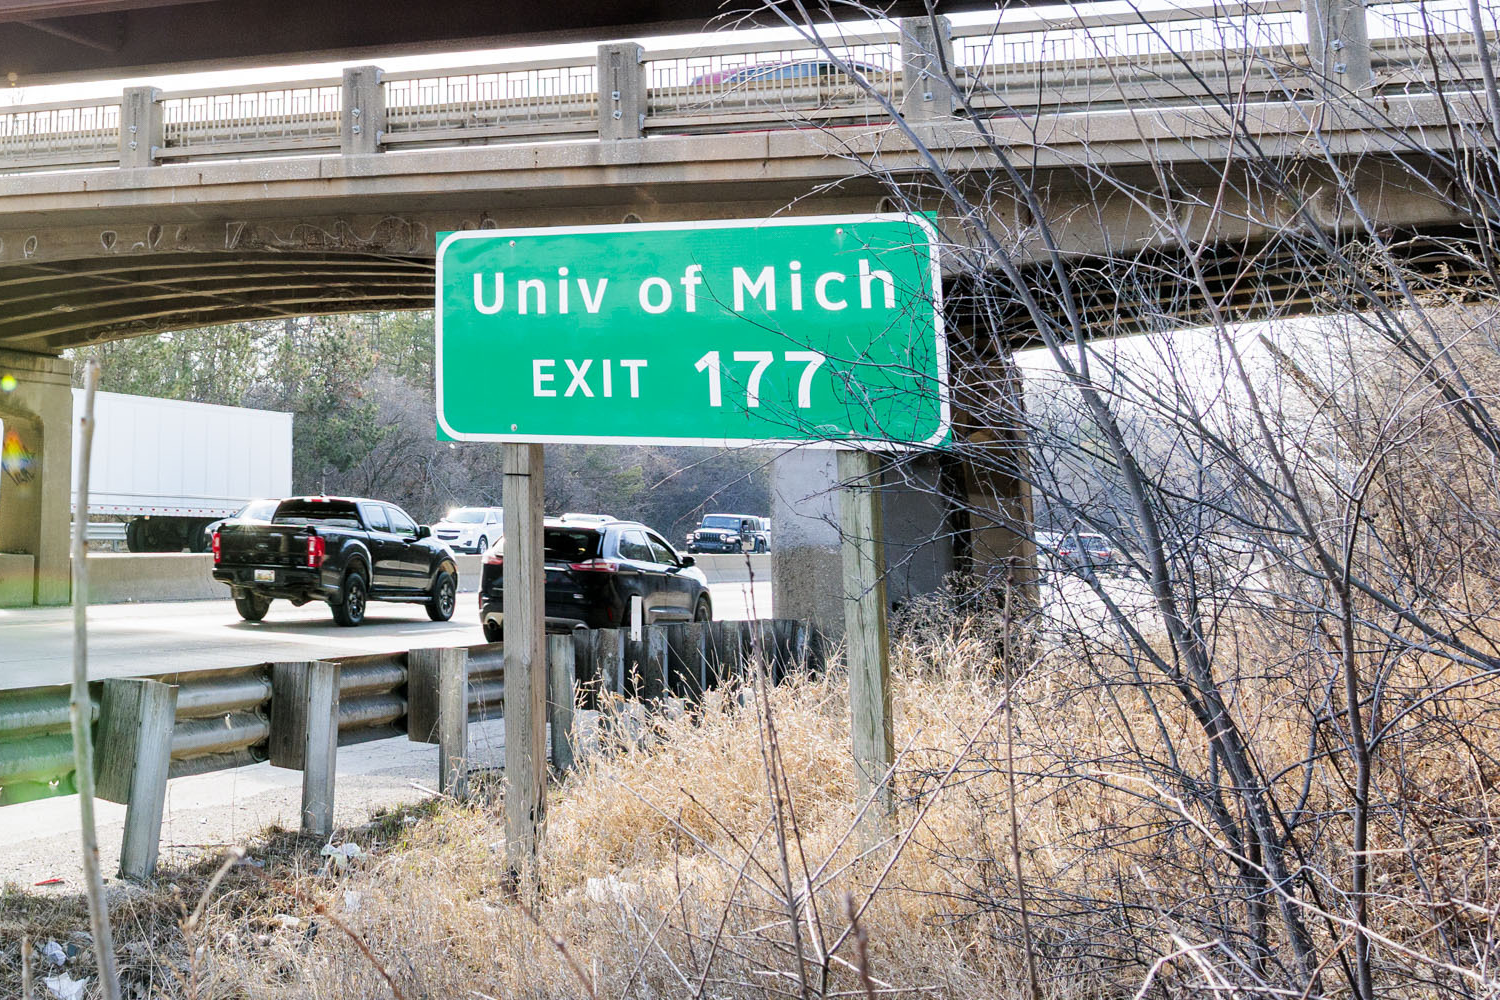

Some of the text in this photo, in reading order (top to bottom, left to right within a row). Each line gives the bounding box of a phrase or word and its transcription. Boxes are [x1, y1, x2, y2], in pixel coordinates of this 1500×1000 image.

[472, 258, 897, 315] Univ of Mich
[531, 350, 826, 409] EXIT 177
